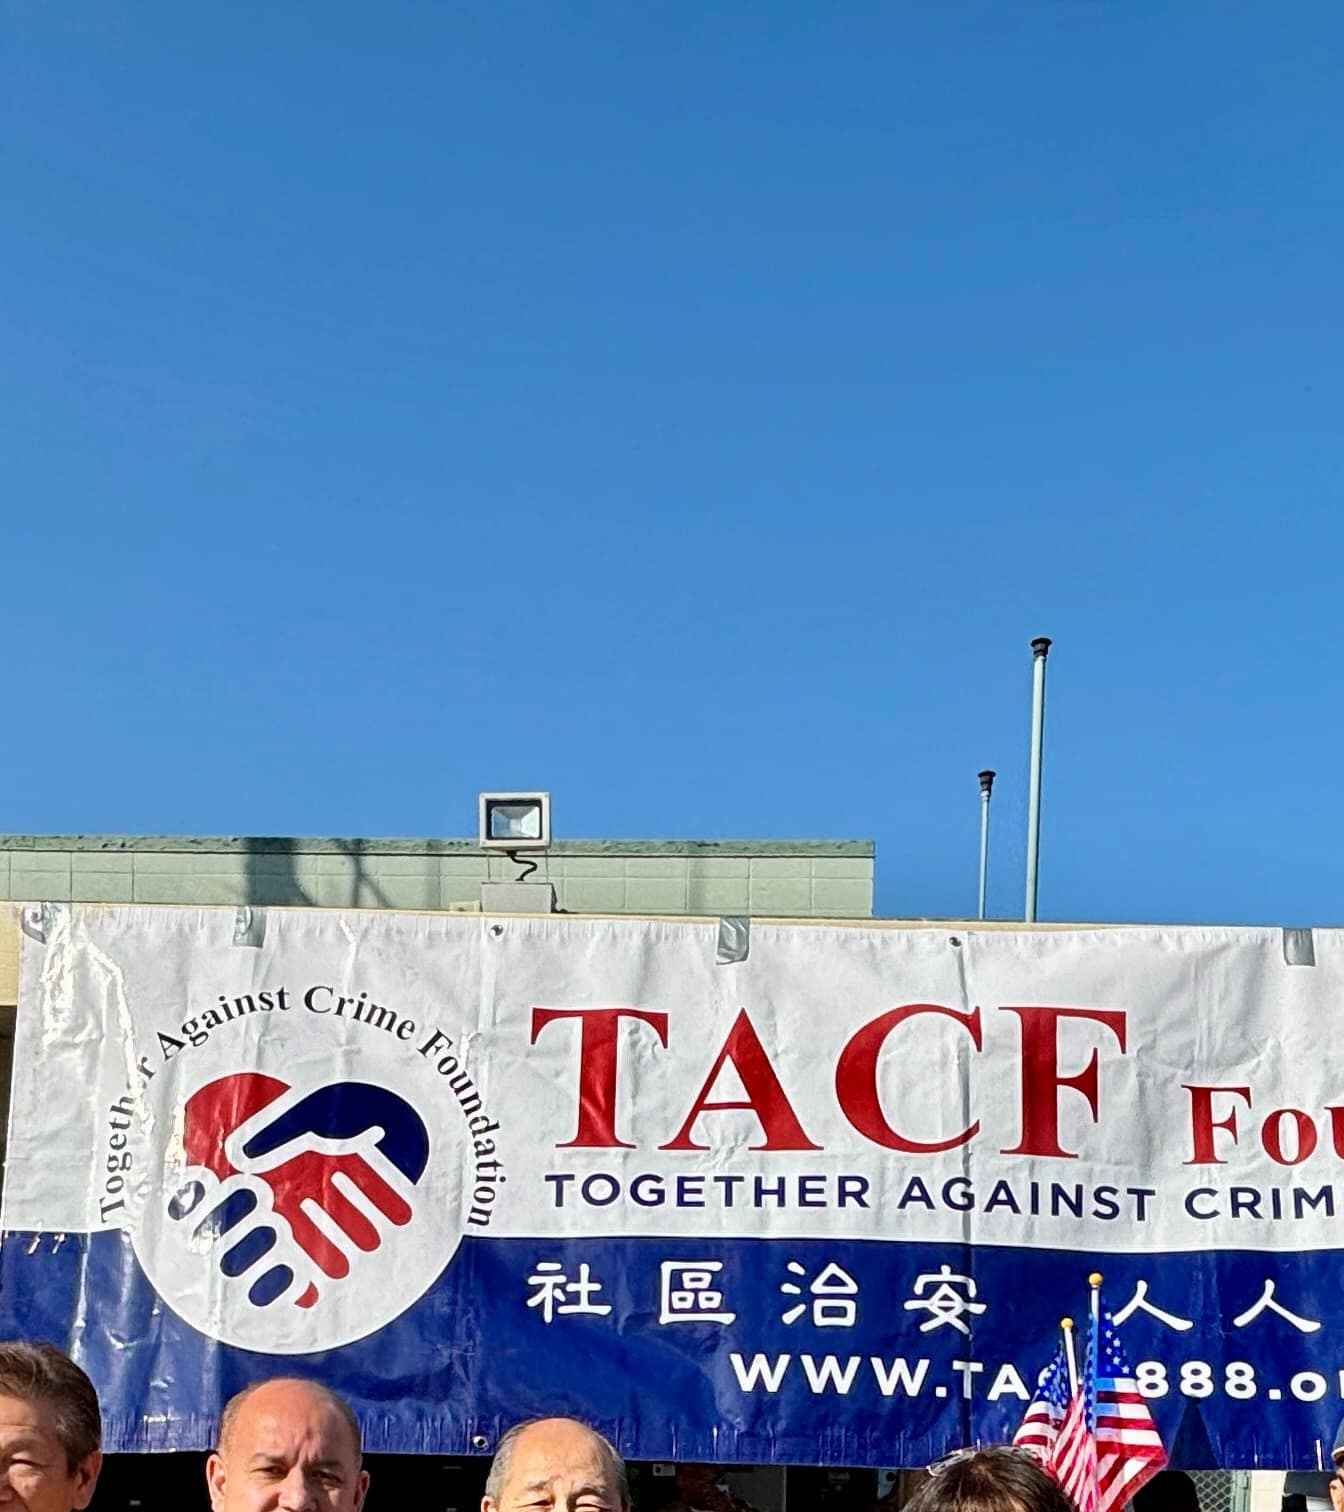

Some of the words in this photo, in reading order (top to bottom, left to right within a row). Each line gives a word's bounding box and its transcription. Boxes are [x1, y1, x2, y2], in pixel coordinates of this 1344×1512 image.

[156, 984, 292, 1062] Against
[303, 984, 418, 1041] Crime
[416, 1027, 508, 1228] Foundation
[530, 1003, 1127, 1159] TACF
[544, 1172, 872, 1209] TOGETHER
[896, 1174, 1156, 1222] AGAINST
